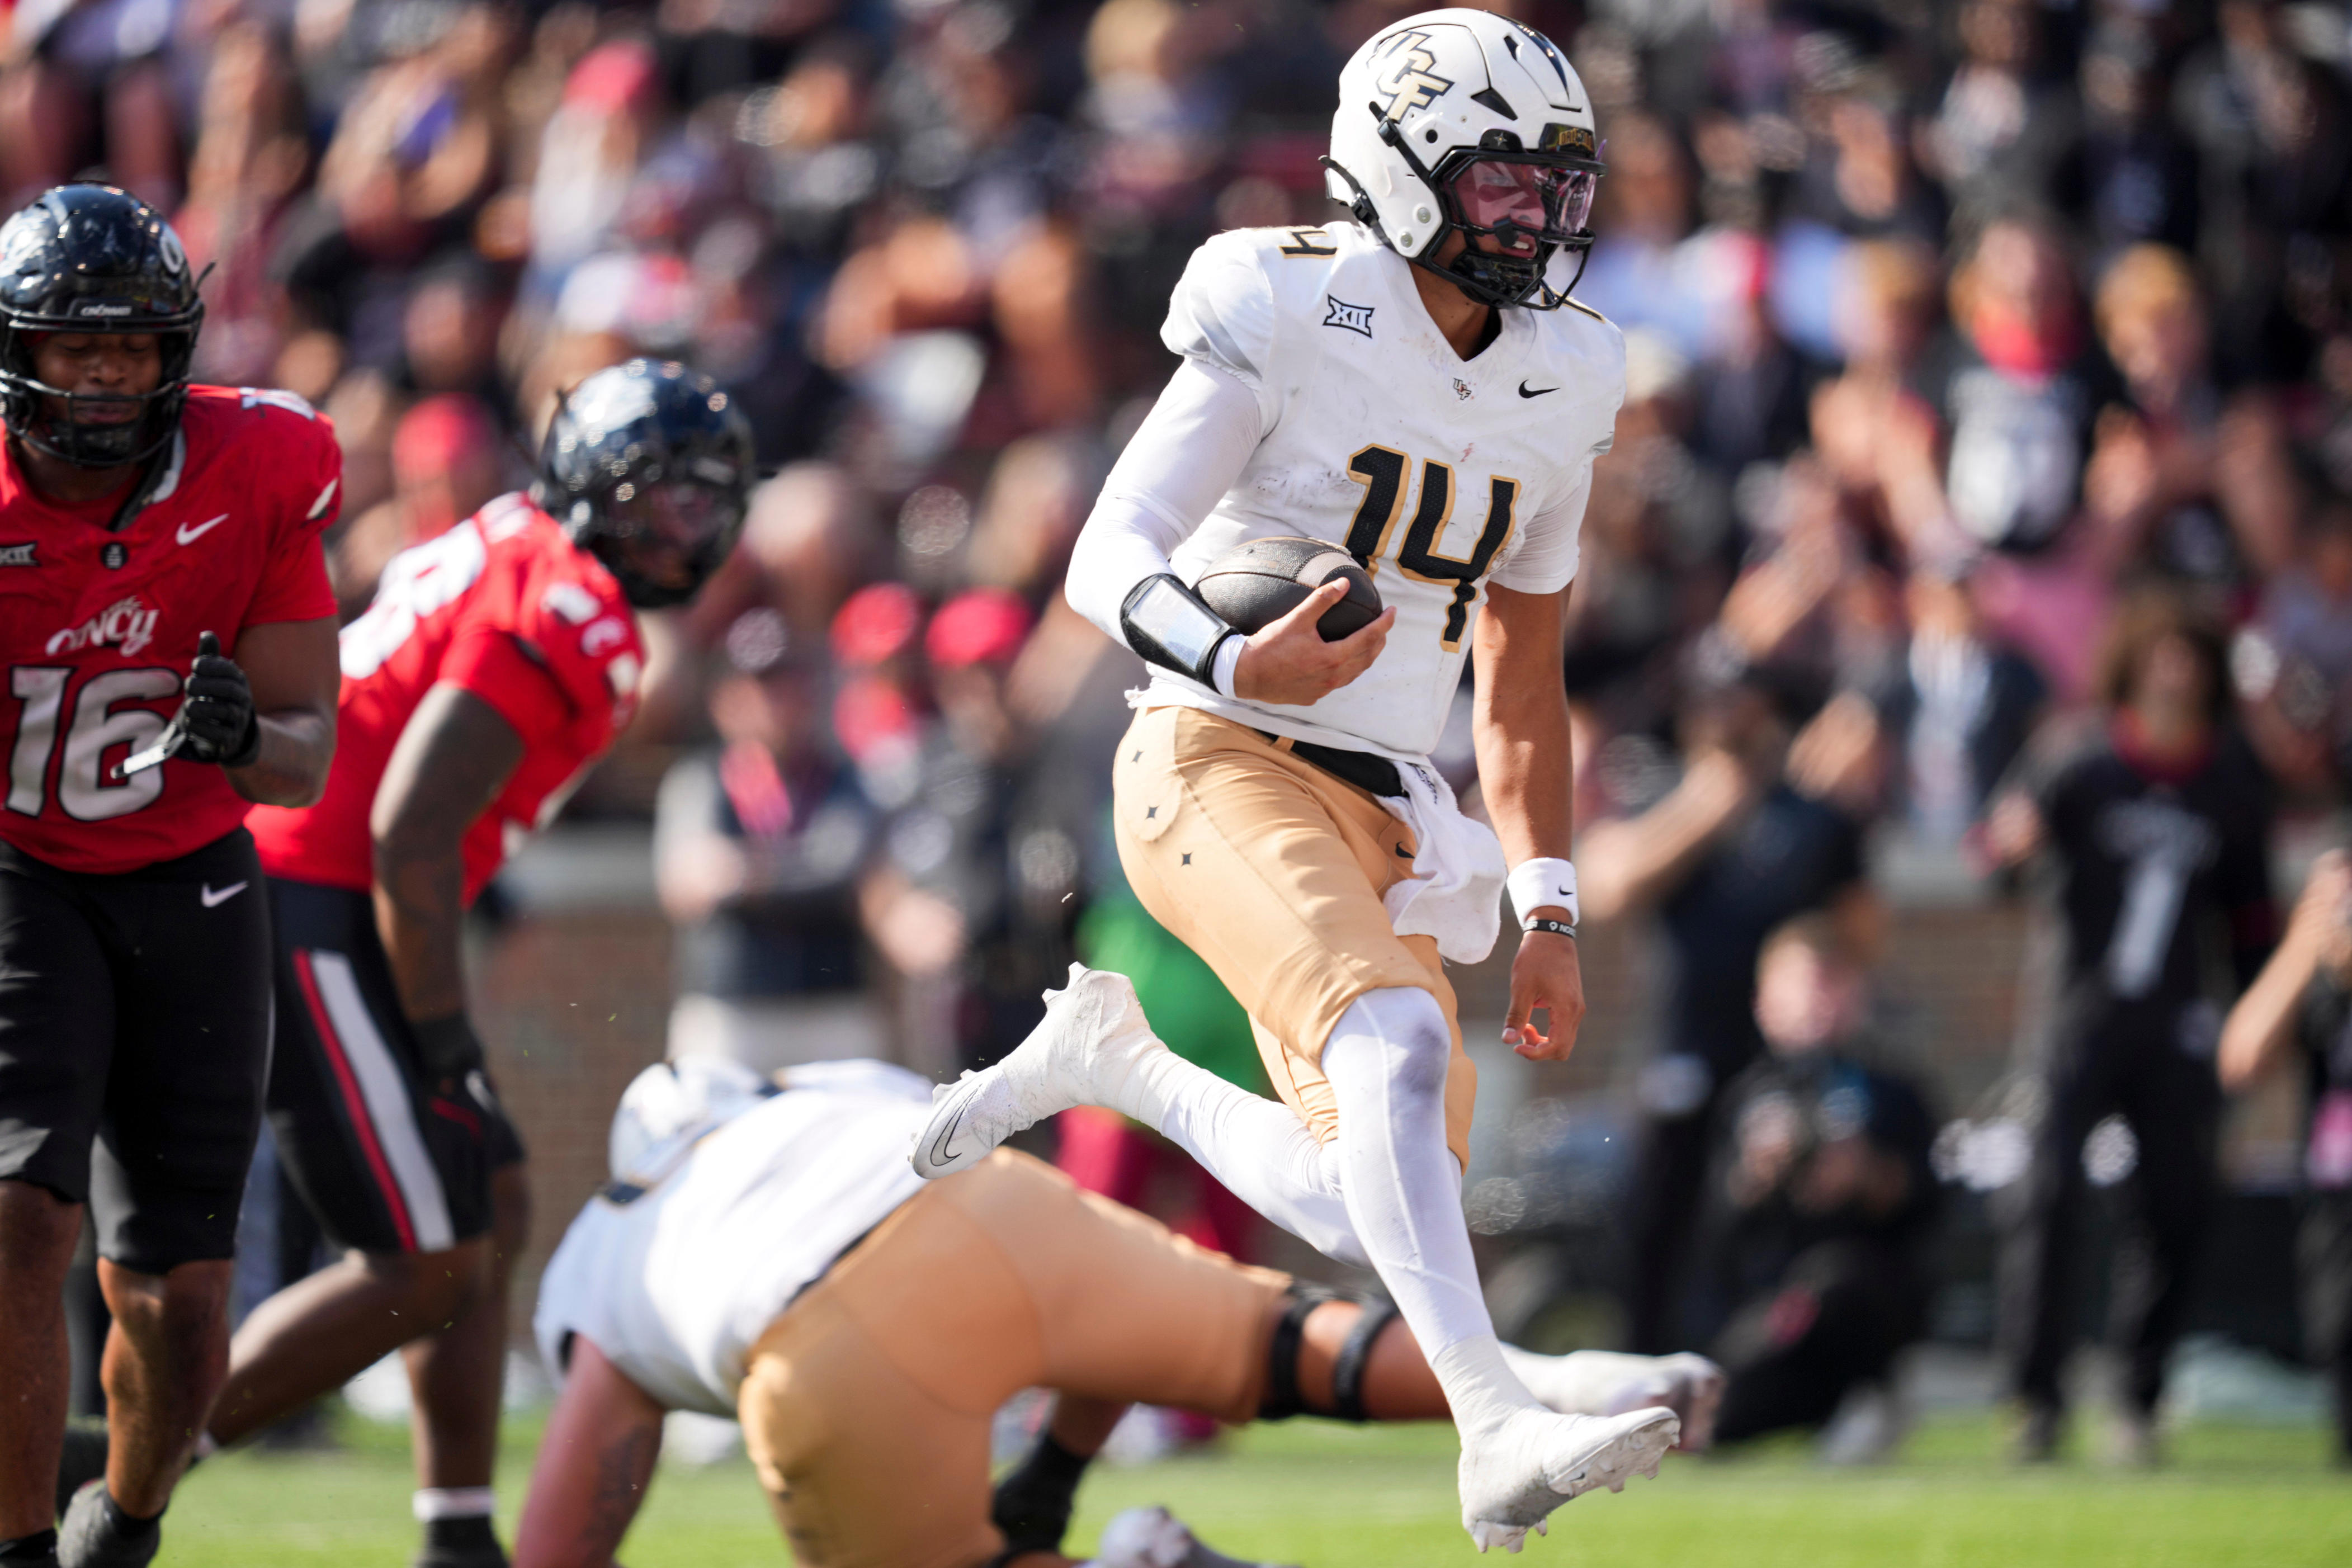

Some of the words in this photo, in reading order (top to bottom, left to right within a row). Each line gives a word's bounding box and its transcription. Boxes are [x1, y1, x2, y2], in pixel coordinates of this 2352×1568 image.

[1366, 31, 1455, 124] UCF
[1453, 377, 1472, 400] UCF
[1343, 443, 1522, 654] 14
[6, 665, 182, 822] 16
